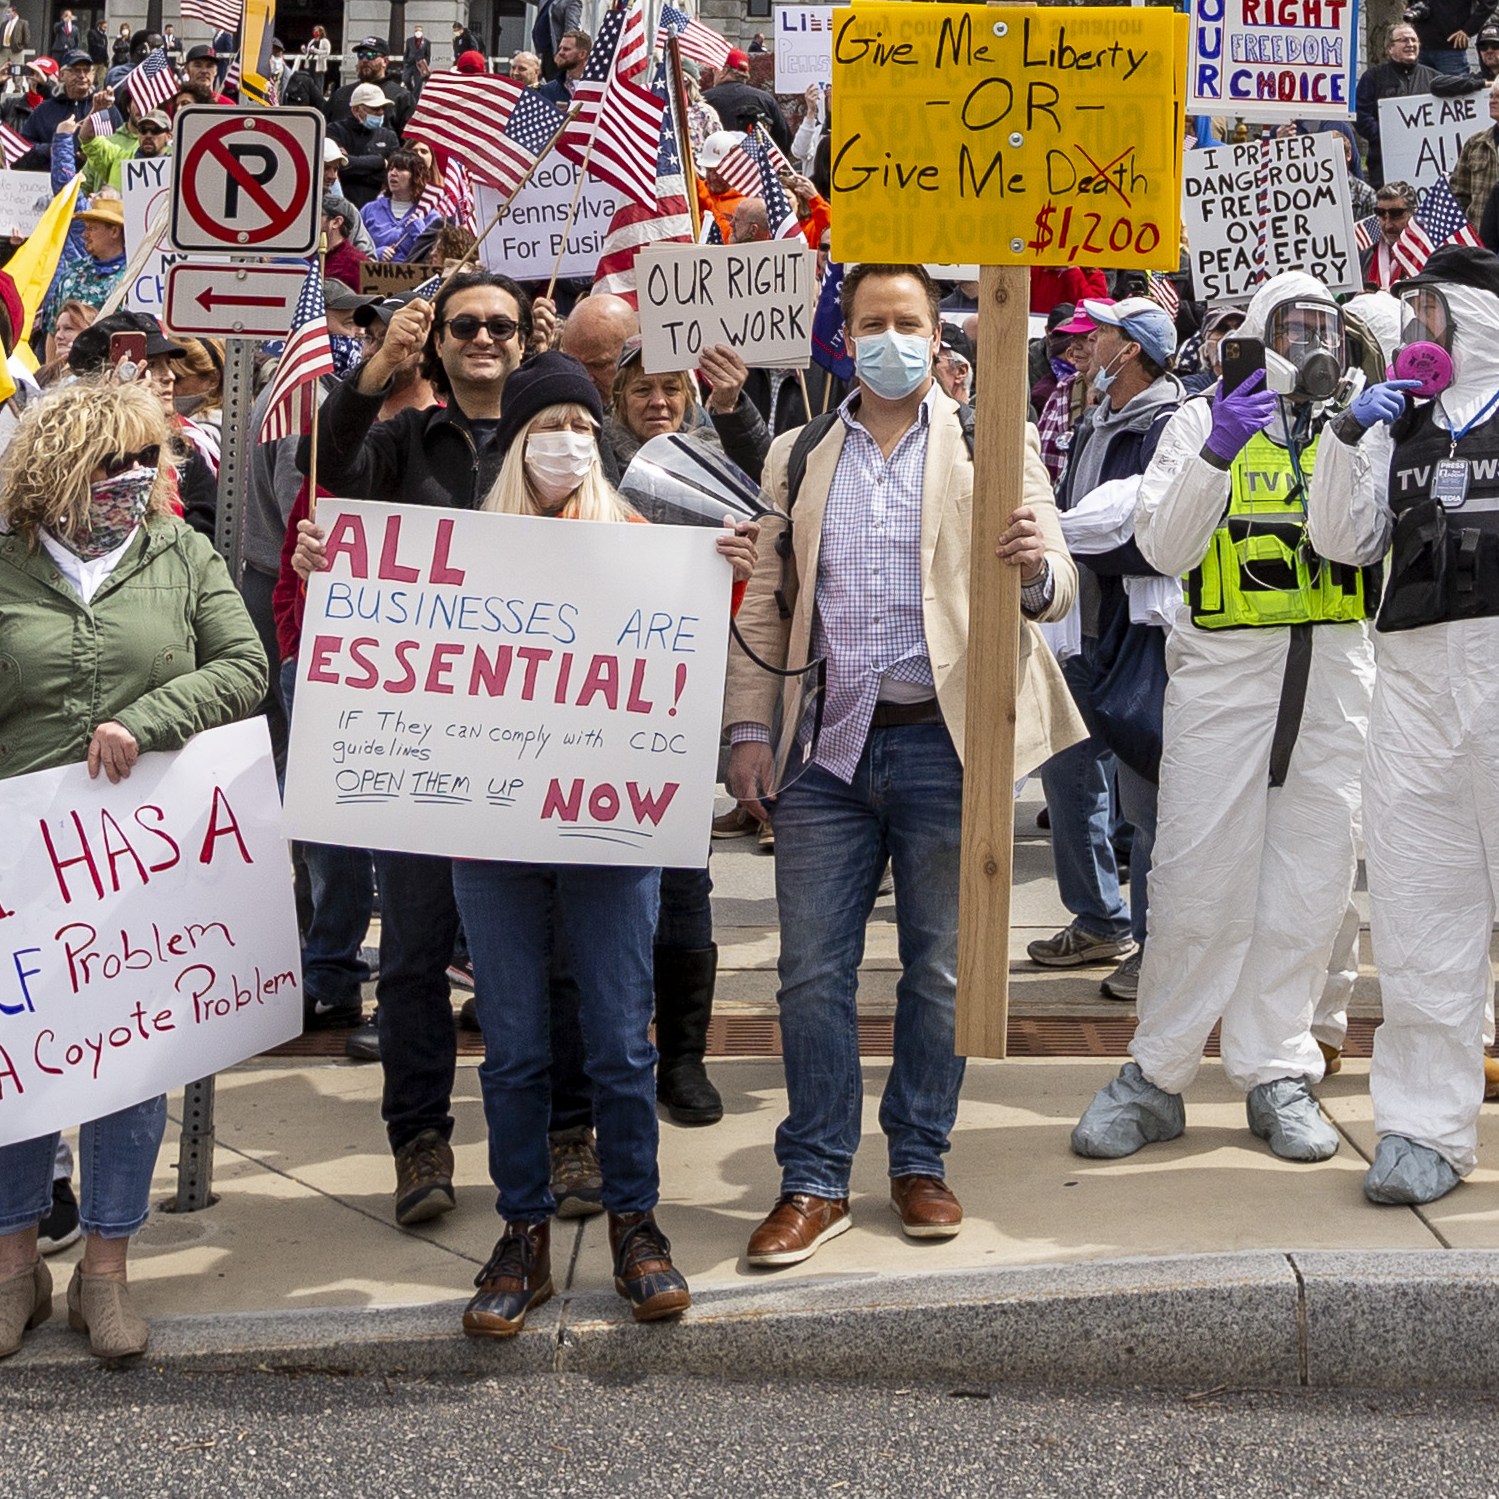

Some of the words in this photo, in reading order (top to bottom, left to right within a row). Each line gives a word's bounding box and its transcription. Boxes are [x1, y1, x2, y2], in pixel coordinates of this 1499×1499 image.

[835, 14, 919, 66] Give
[935, 12, 990, 69] Me
[1023, 16, 1150, 81] Liberty
[1230, 33, 1344, 65] FREEDOM
[1229, 69, 1346, 102] CHOICE
[1396, 102, 1435, 129] WE
[1439, 99, 1477, 125] ARE
[831, 133, 940, 194] Give
[958, 142, 1027, 199] Me
[1204, 149, 1219, 170] I
[1233, 135, 1316, 167] PRFER
[502, 236, 541, 261] For
[1027, 199, 1161, 261] $1,200
[647, 262, 715, 307] OUR
[728, 252, 804, 299] RIGHT
[1203, 259, 1347, 300] SLARY
[662, 316, 702, 356] TO
[719, 303, 807, 347] WORK
[1244, 471, 1279, 492] TV
[1396, 465, 1432, 491] TV
[317, 512, 466, 587] ALL
[325, 582, 580, 645] BUSINESSES
[616, 608, 700, 653] ARE
[306, 634, 688, 717] ESSENTIAL!
[377, 710, 433, 746] They
[488, 725, 552, 761] comply
[562, 728, 604, 748] with
[629, 731, 688, 755] CDC
[335, 768, 406, 793] OPEN
[412, 770, 472, 795] THEM
[540, 778, 680, 827] NOW
[39, 804, 181, 904] HAS
[199, 785, 254, 865] A
[54, 921, 236, 994] Problem
[34, 1000, 177, 1080] Coyote
[175, 963, 298, 1024] Problem
